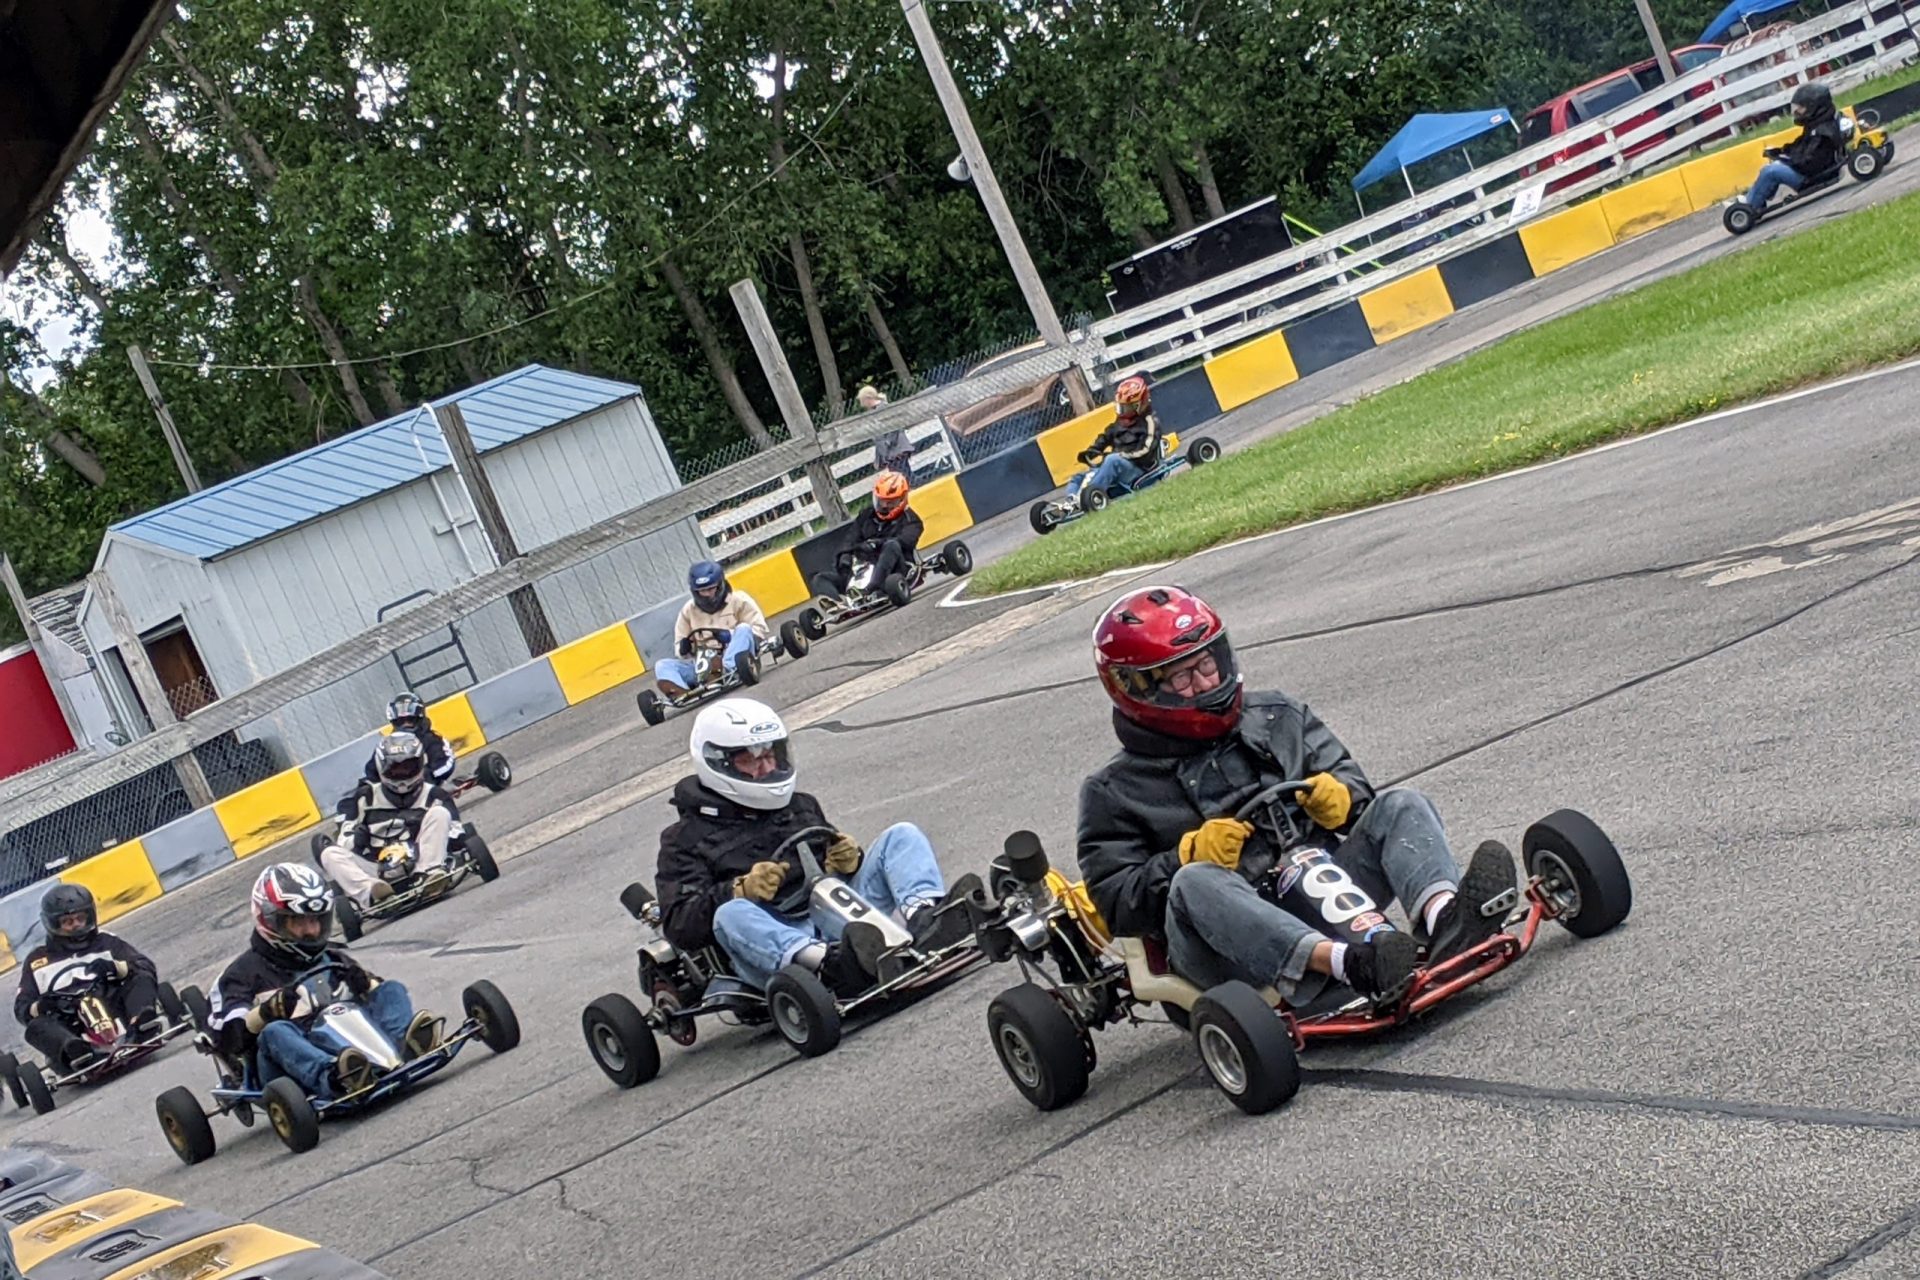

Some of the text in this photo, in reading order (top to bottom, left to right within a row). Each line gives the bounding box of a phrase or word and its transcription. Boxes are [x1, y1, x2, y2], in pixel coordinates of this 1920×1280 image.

[695, 649, 709, 674] 6
[829, 886, 871, 919] 9
[1303, 863, 1377, 924] 8
[80, 996, 112, 1028] 11
